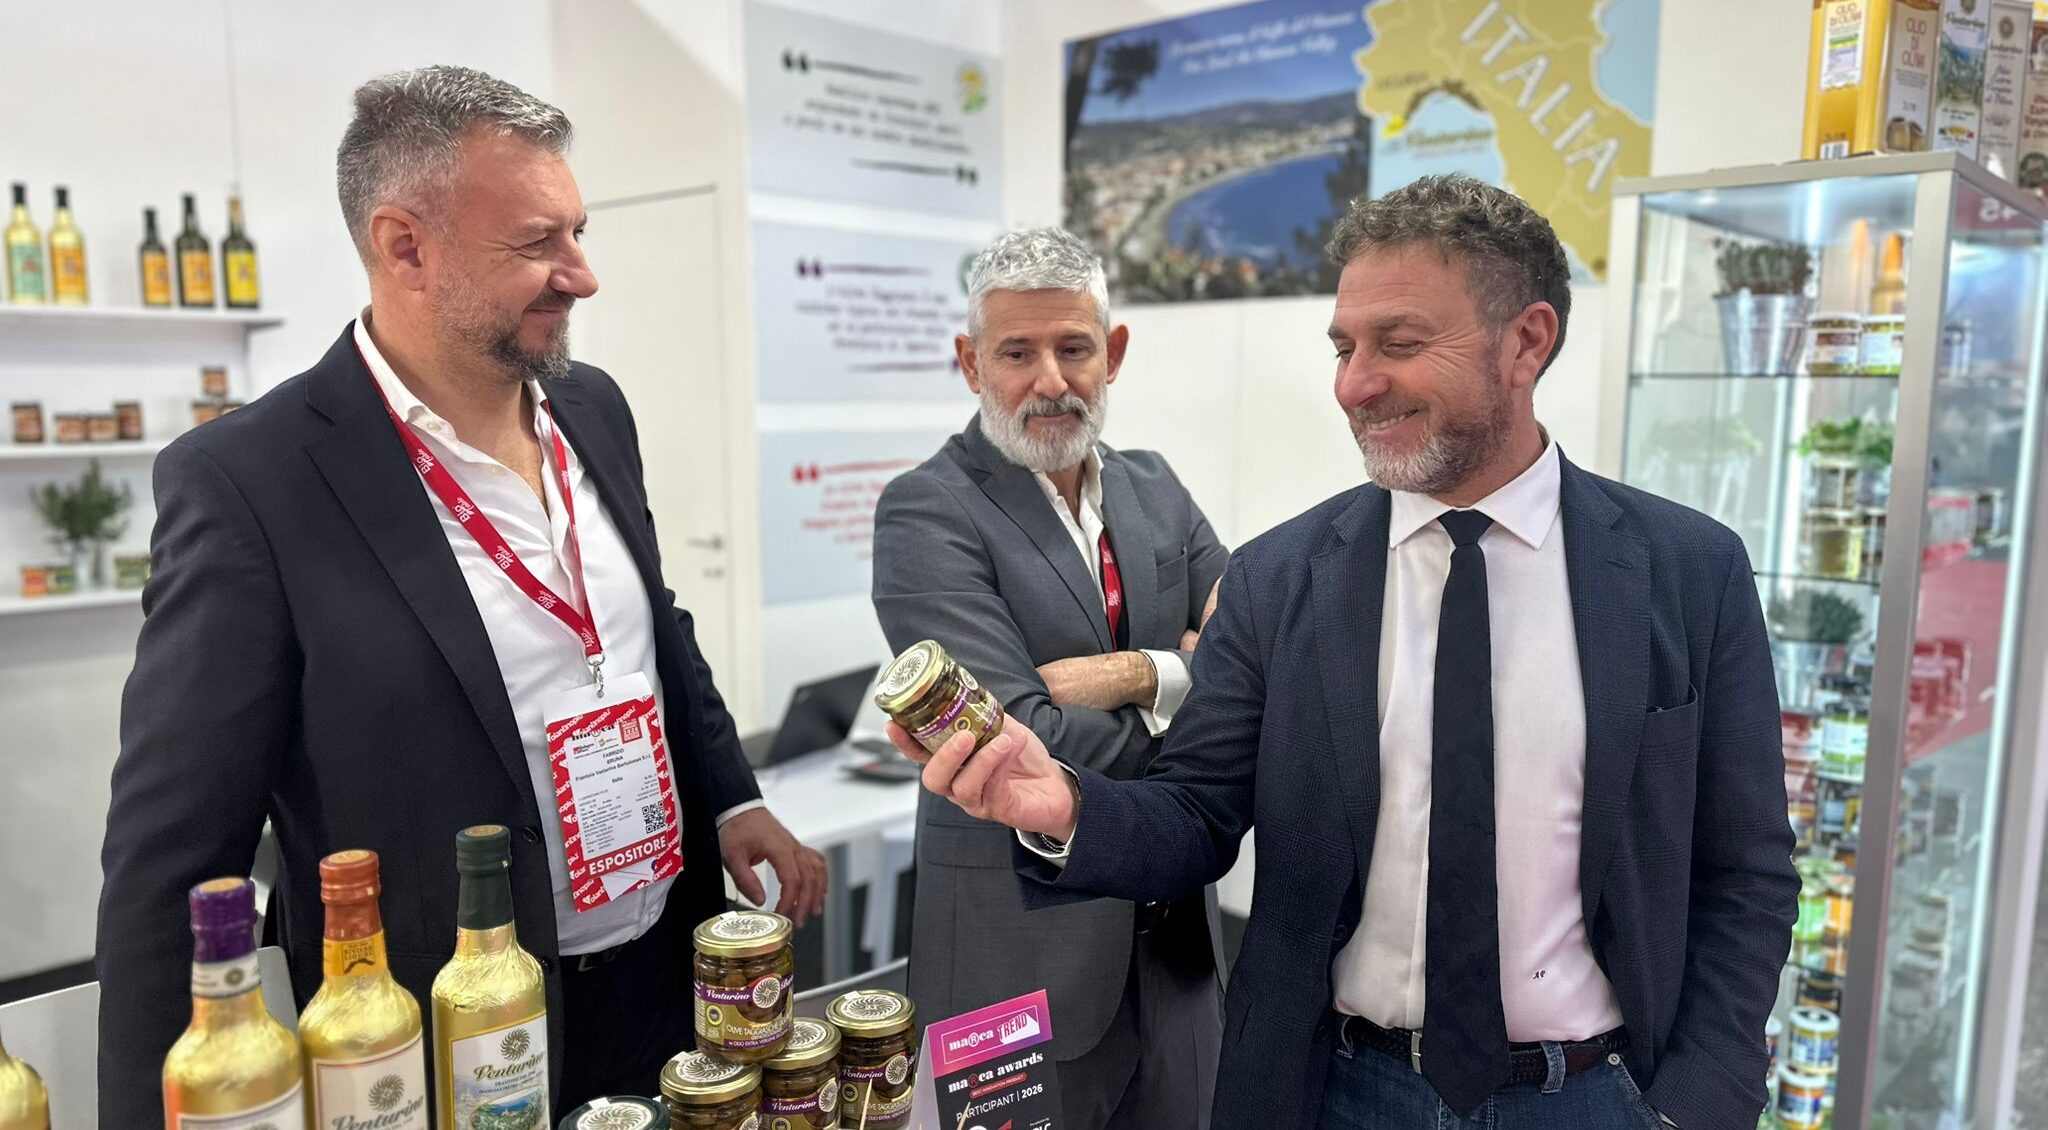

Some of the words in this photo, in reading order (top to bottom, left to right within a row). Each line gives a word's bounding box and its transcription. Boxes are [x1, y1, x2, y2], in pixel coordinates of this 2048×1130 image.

[1906, 18, 1926, 35] OLIO
[1902, 50, 1926, 69] OLIVA
[1461, 0, 1621, 193] ITALIA
[588, 836, 666, 875] ESPOSITORE
[706, 989, 750, 1000] Venturino
[726, 1024, 743, 1036] OLIVE
[997, 1012, 1028, 1041] TREND
[842, 1068, 883, 1079] Venturino
[997, 1052, 1044, 1077] awards
[1021, 1083, 1044, 1099] 2026
[331, 1095, 424, 1130] Venturino
[772, 1101, 817, 1111] Venturino
